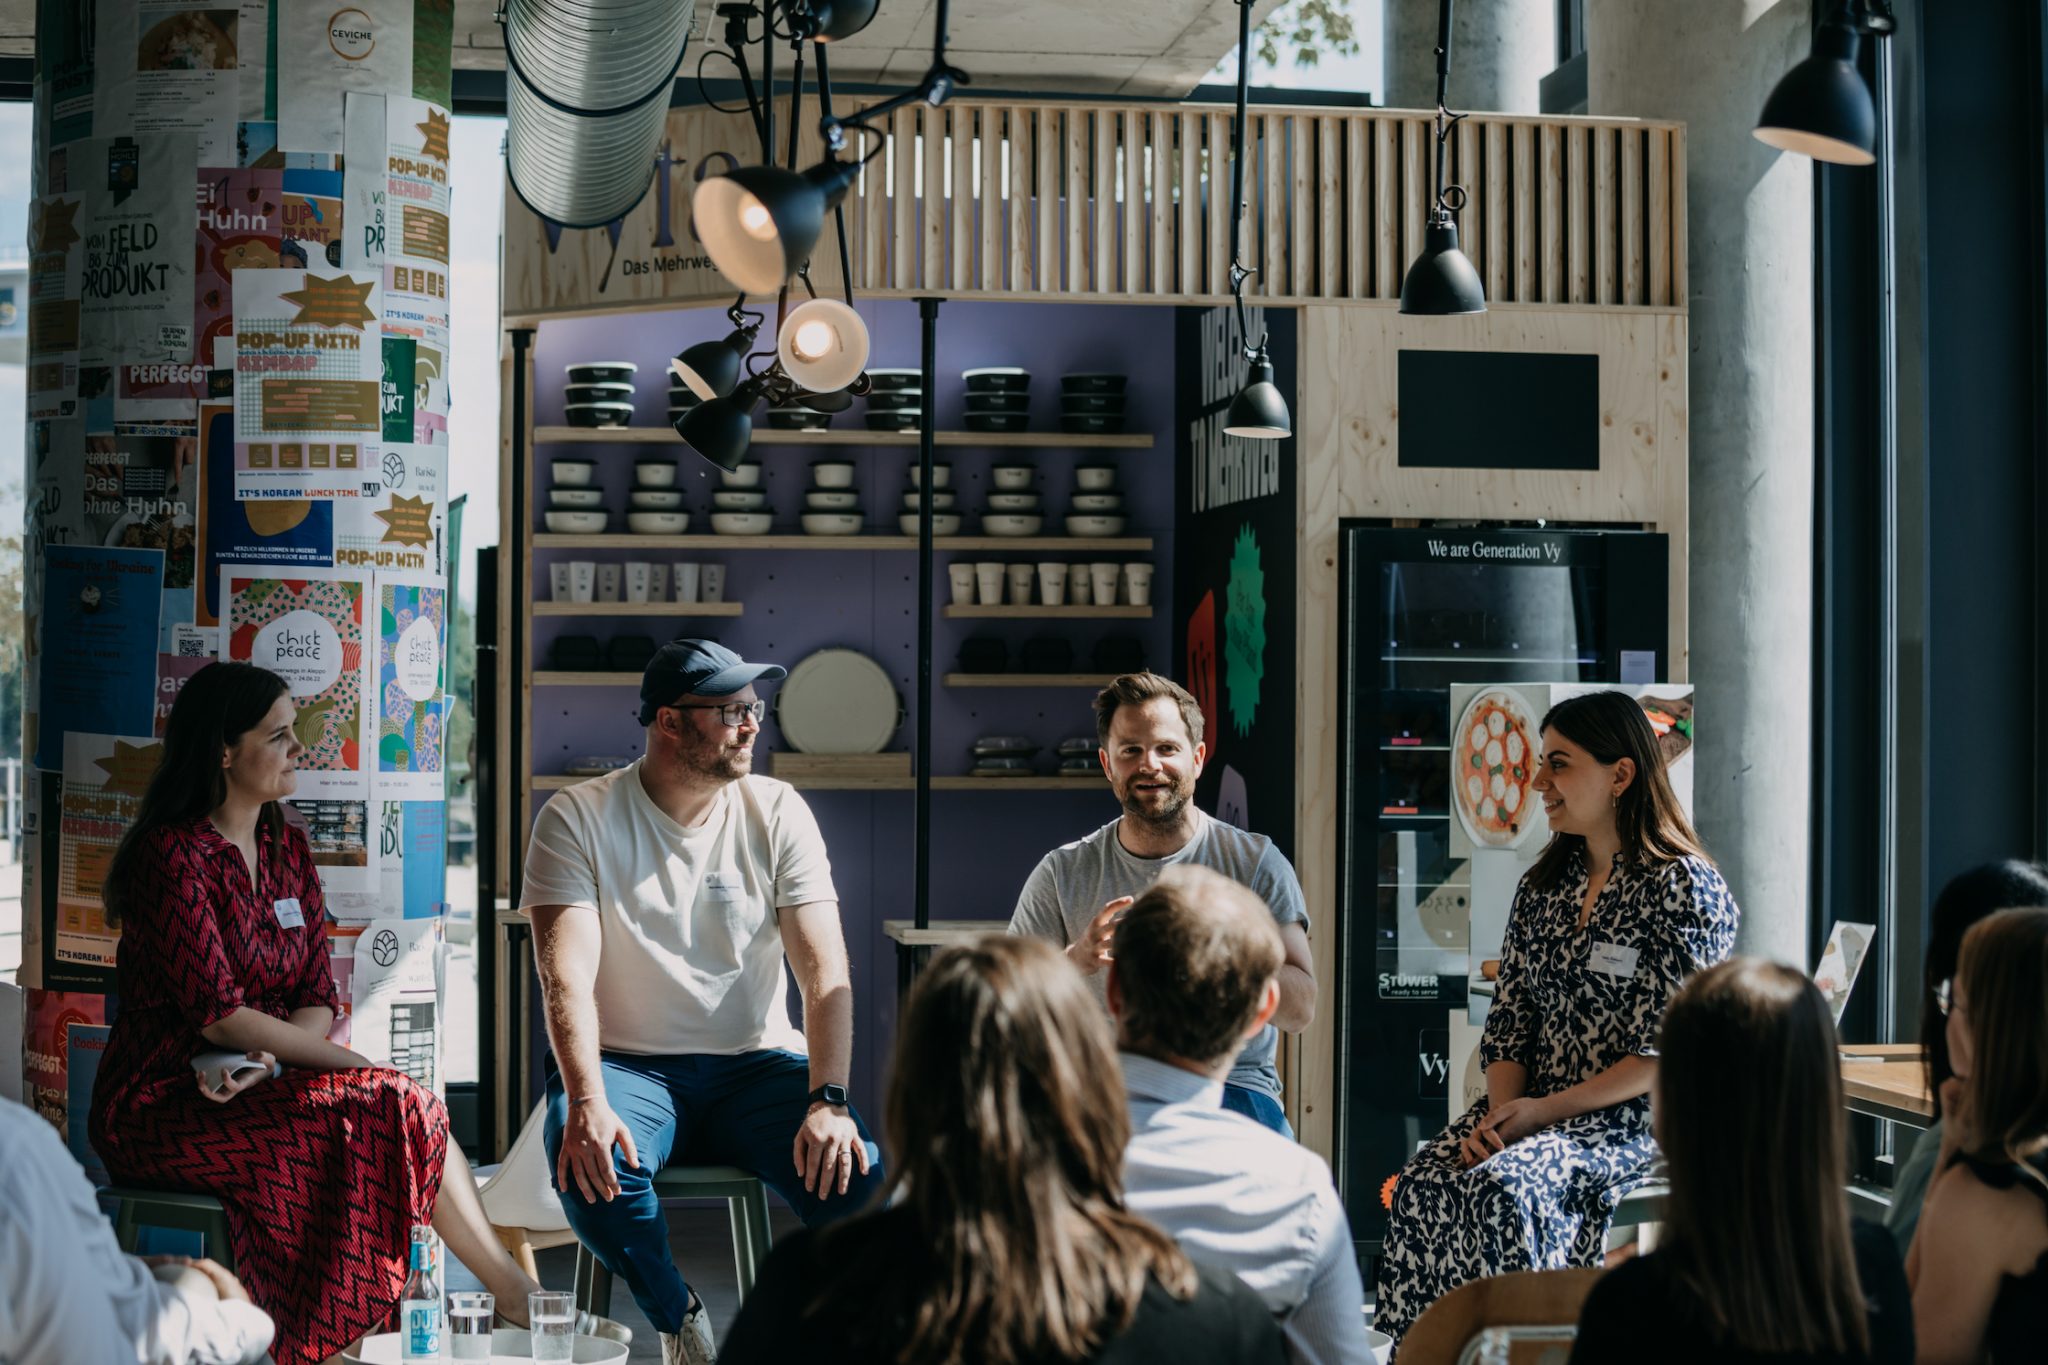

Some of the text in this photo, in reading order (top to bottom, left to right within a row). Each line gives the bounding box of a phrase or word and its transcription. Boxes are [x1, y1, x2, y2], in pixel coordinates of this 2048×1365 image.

[388, 156, 430, 178] POP-UP
[195, 208, 268, 232] Huhn
[109, 222, 159, 254] FELD
[623, 259, 650, 276] Das
[81, 260, 170, 304] PRODUKT
[236, 332, 360, 351] POP-UP WITH
[236, 355, 318, 372] KIMBAP
[130, 364, 213, 385] PERFEGGT
[84, 474, 119, 492] Das
[238, 488, 260, 498] IT'S
[261, 488, 303, 498] KOREAN
[304, 488, 335, 498] LUNCH
[337, 488, 359, 498] TIME
[82, 495, 188, 516] ohne Huhn
[335, 549, 425, 569] POP-UP WITH
[1427, 539, 1562, 564] We are Generation Vy
[276, 645, 321, 662] peace
[57, 948, 72, 959] IT'S
[72, 951, 102, 964] KOREAN
[1391, 988, 1439, 998] ready to serve
[1419, 1052, 1450, 1085] Vy
